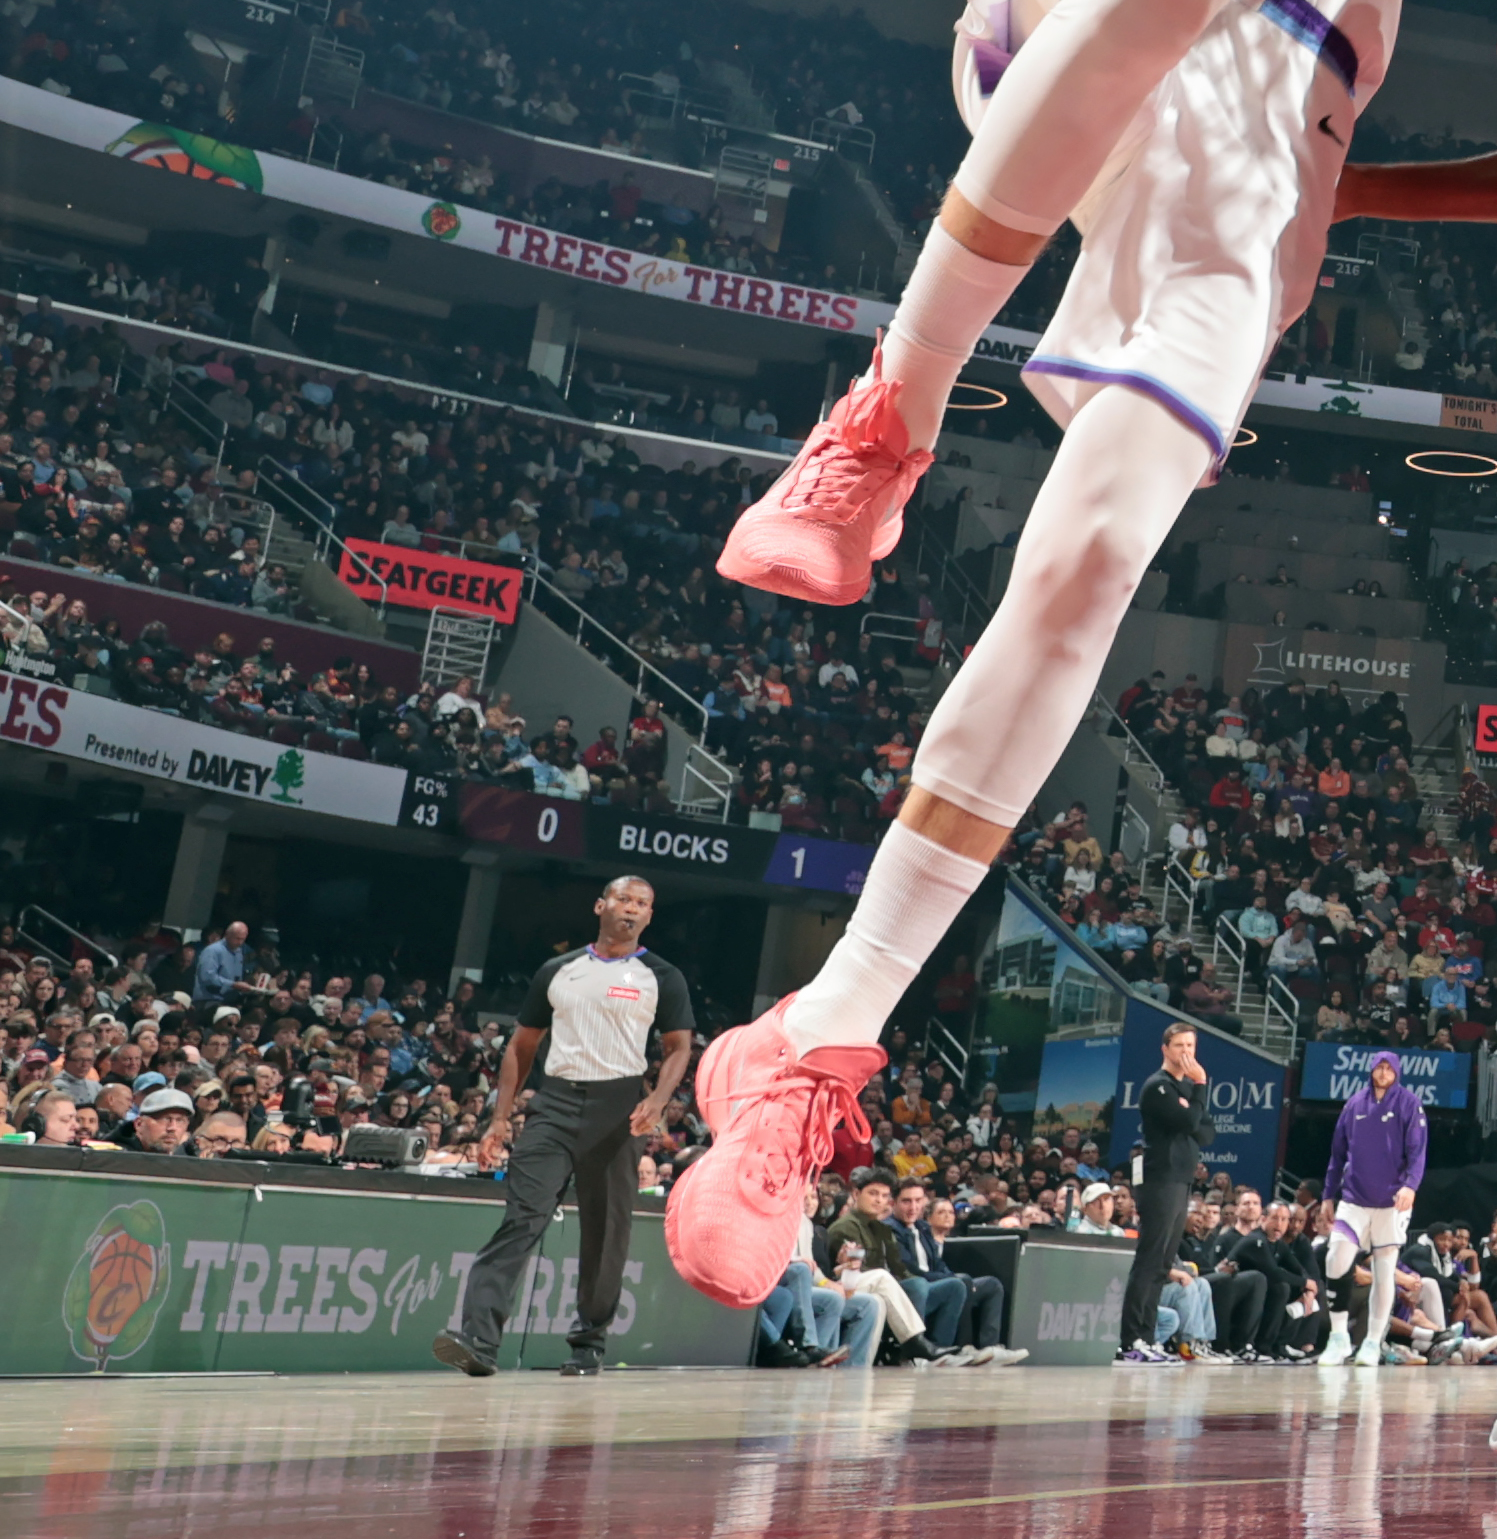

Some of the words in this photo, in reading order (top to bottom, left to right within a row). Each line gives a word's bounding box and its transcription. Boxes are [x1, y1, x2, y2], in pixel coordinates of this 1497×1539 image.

[245, 7, 275, 24] 214
[495, 219, 633, 286] TREES
[634, 260, 678, 292] For
[683, 266, 858, 332] THREES
[1444, 396, 1497, 414] TONIGHT'S
[1453, 415, 1484, 430] TOTAL
[346, 551, 510, 612] SEATGEEK
[1285, 651, 1410, 679] LITEHOUSE
[86, 733, 158, 768] Presented
[161, 749, 179, 778] by
[187, 749, 272, 796] DAVEY
[414, 777, 448, 798] FG%
[412, 804, 438, 827] 43
[537, 807, 558, 842] 0
[619, 824, 728, 863] BLOCKS
[793, 848, 805, 878] 1
[180, 1240, 387, 1334] TREES
[384, 1254, 443, 1335] For
[1037, 1301, 1101, 1341] DAVEY
